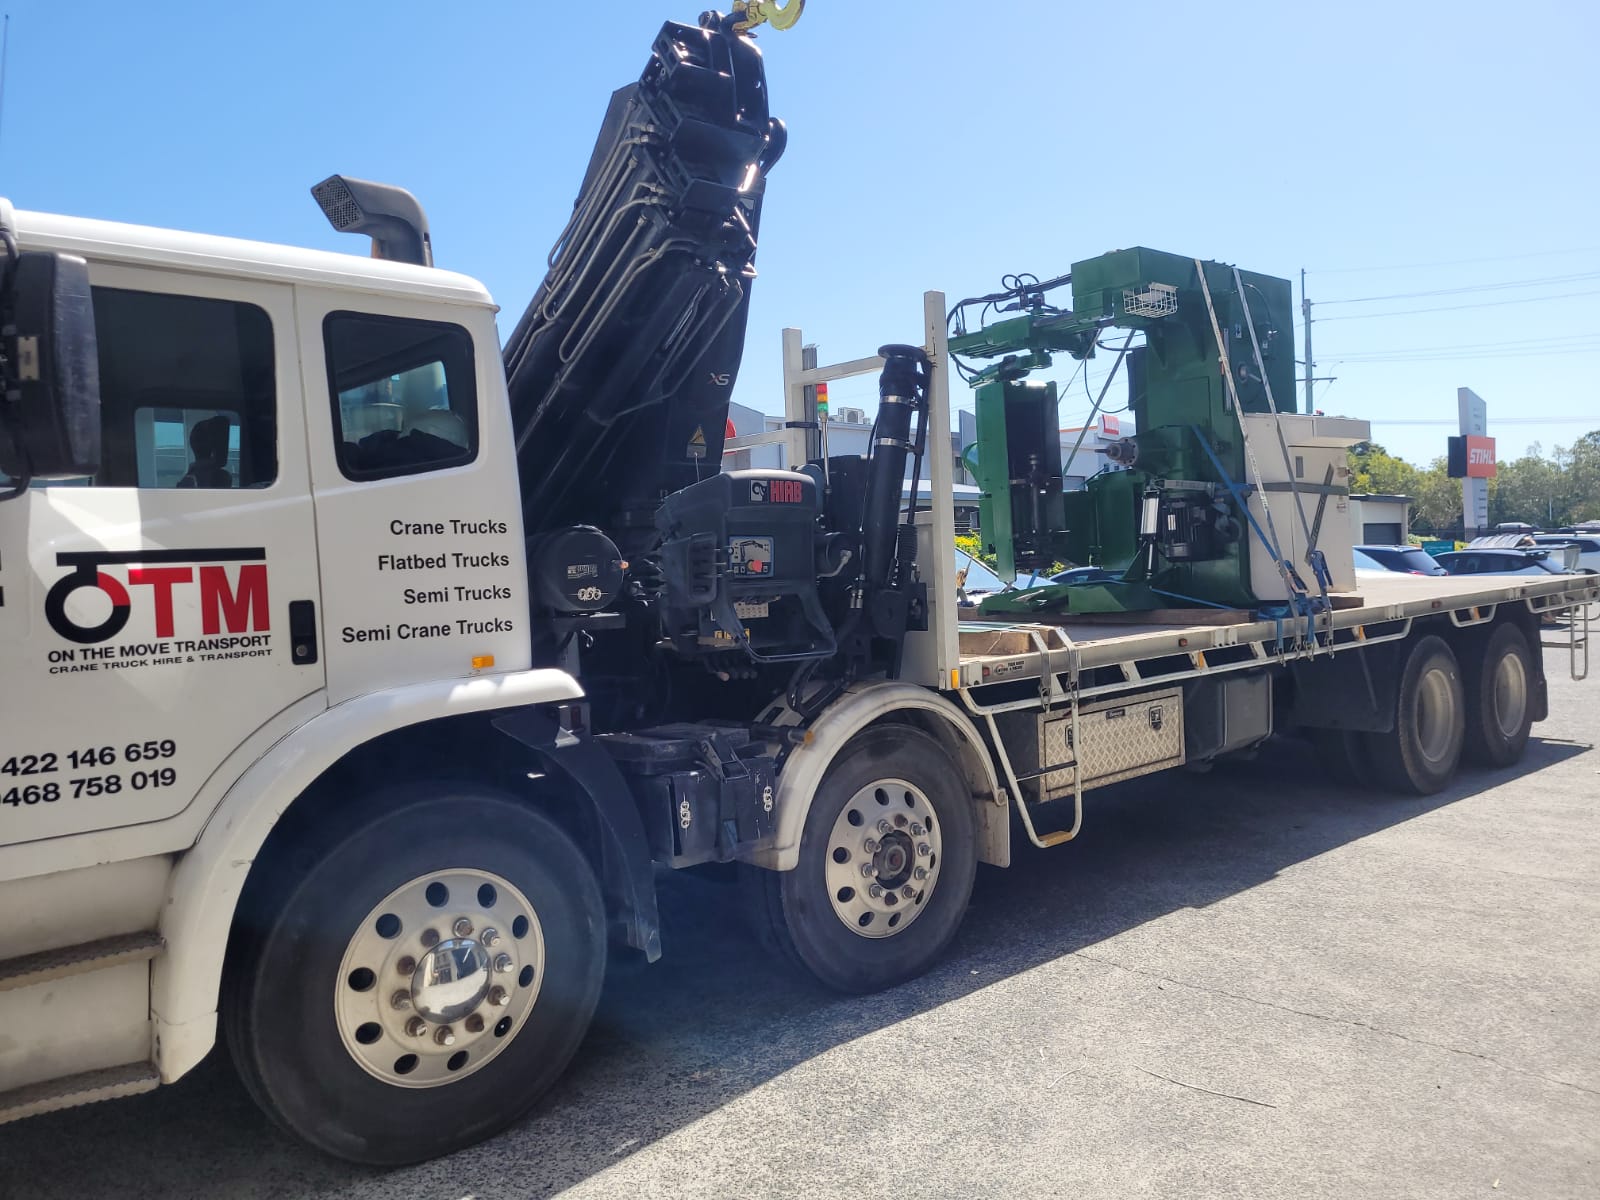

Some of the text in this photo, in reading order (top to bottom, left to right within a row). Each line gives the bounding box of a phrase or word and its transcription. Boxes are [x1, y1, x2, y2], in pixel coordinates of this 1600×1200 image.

[1469, 448, 1494, 465] STIHL
[770, 480, 802, 503] HIAB
[390, 519, 507, 535] Crane Trucks
[378, 552, 510, 571] Flatbed Trucks
[45, 547, 271, 644] OTM
[404, 585, 512, 604] Semi Trucks
[342, 617, 513, 643] Semi Crane Trucks
[47, 634, 272, 663] ON THE MOVE TRANSPORT
[49, 648, 273, 674] CRANE TRUCK HIRE & TRANSPORT
[1, 739, 176, 777] 422 146 659
[0, 767, 176, 807] 468 758 019
